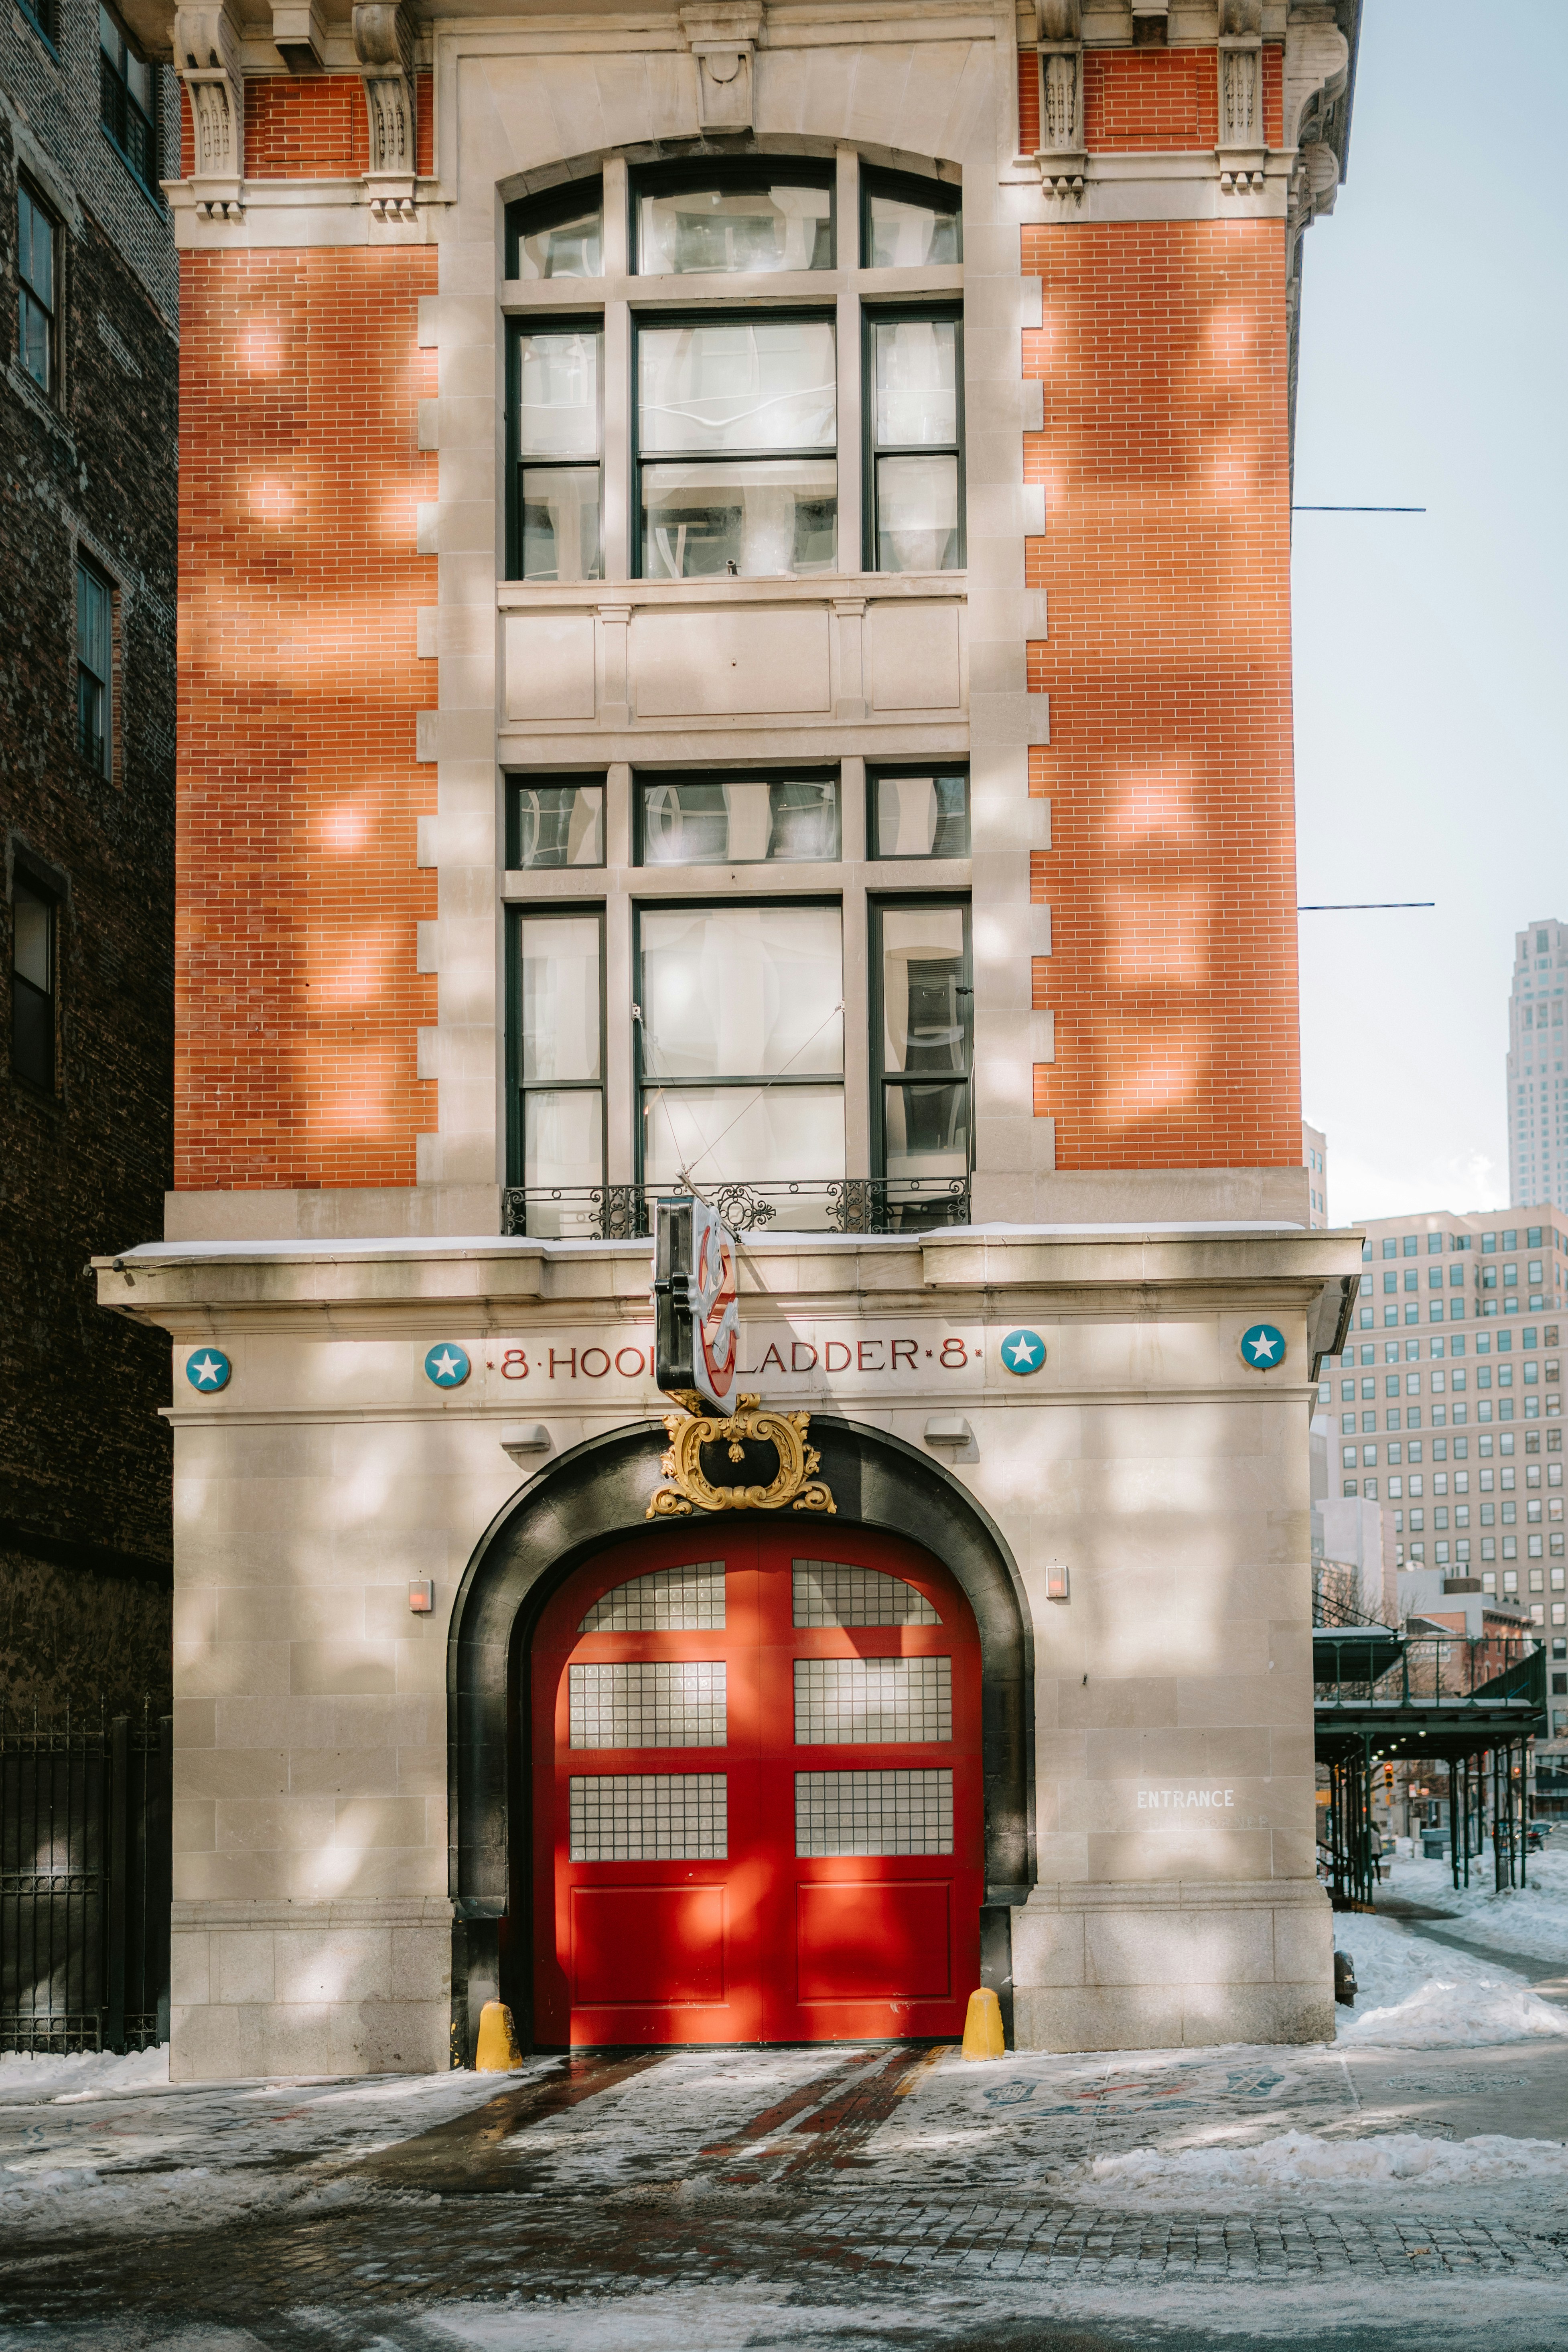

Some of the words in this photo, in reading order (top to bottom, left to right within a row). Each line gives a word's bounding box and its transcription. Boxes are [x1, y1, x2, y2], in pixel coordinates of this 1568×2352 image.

[501, 1349, 529, 1379] 8
[548, 1346, 655, 1378] HOO
[939, 1338, 968, 1368] 8
[1137, 1790, 1235, 1808] ENTRANCE
